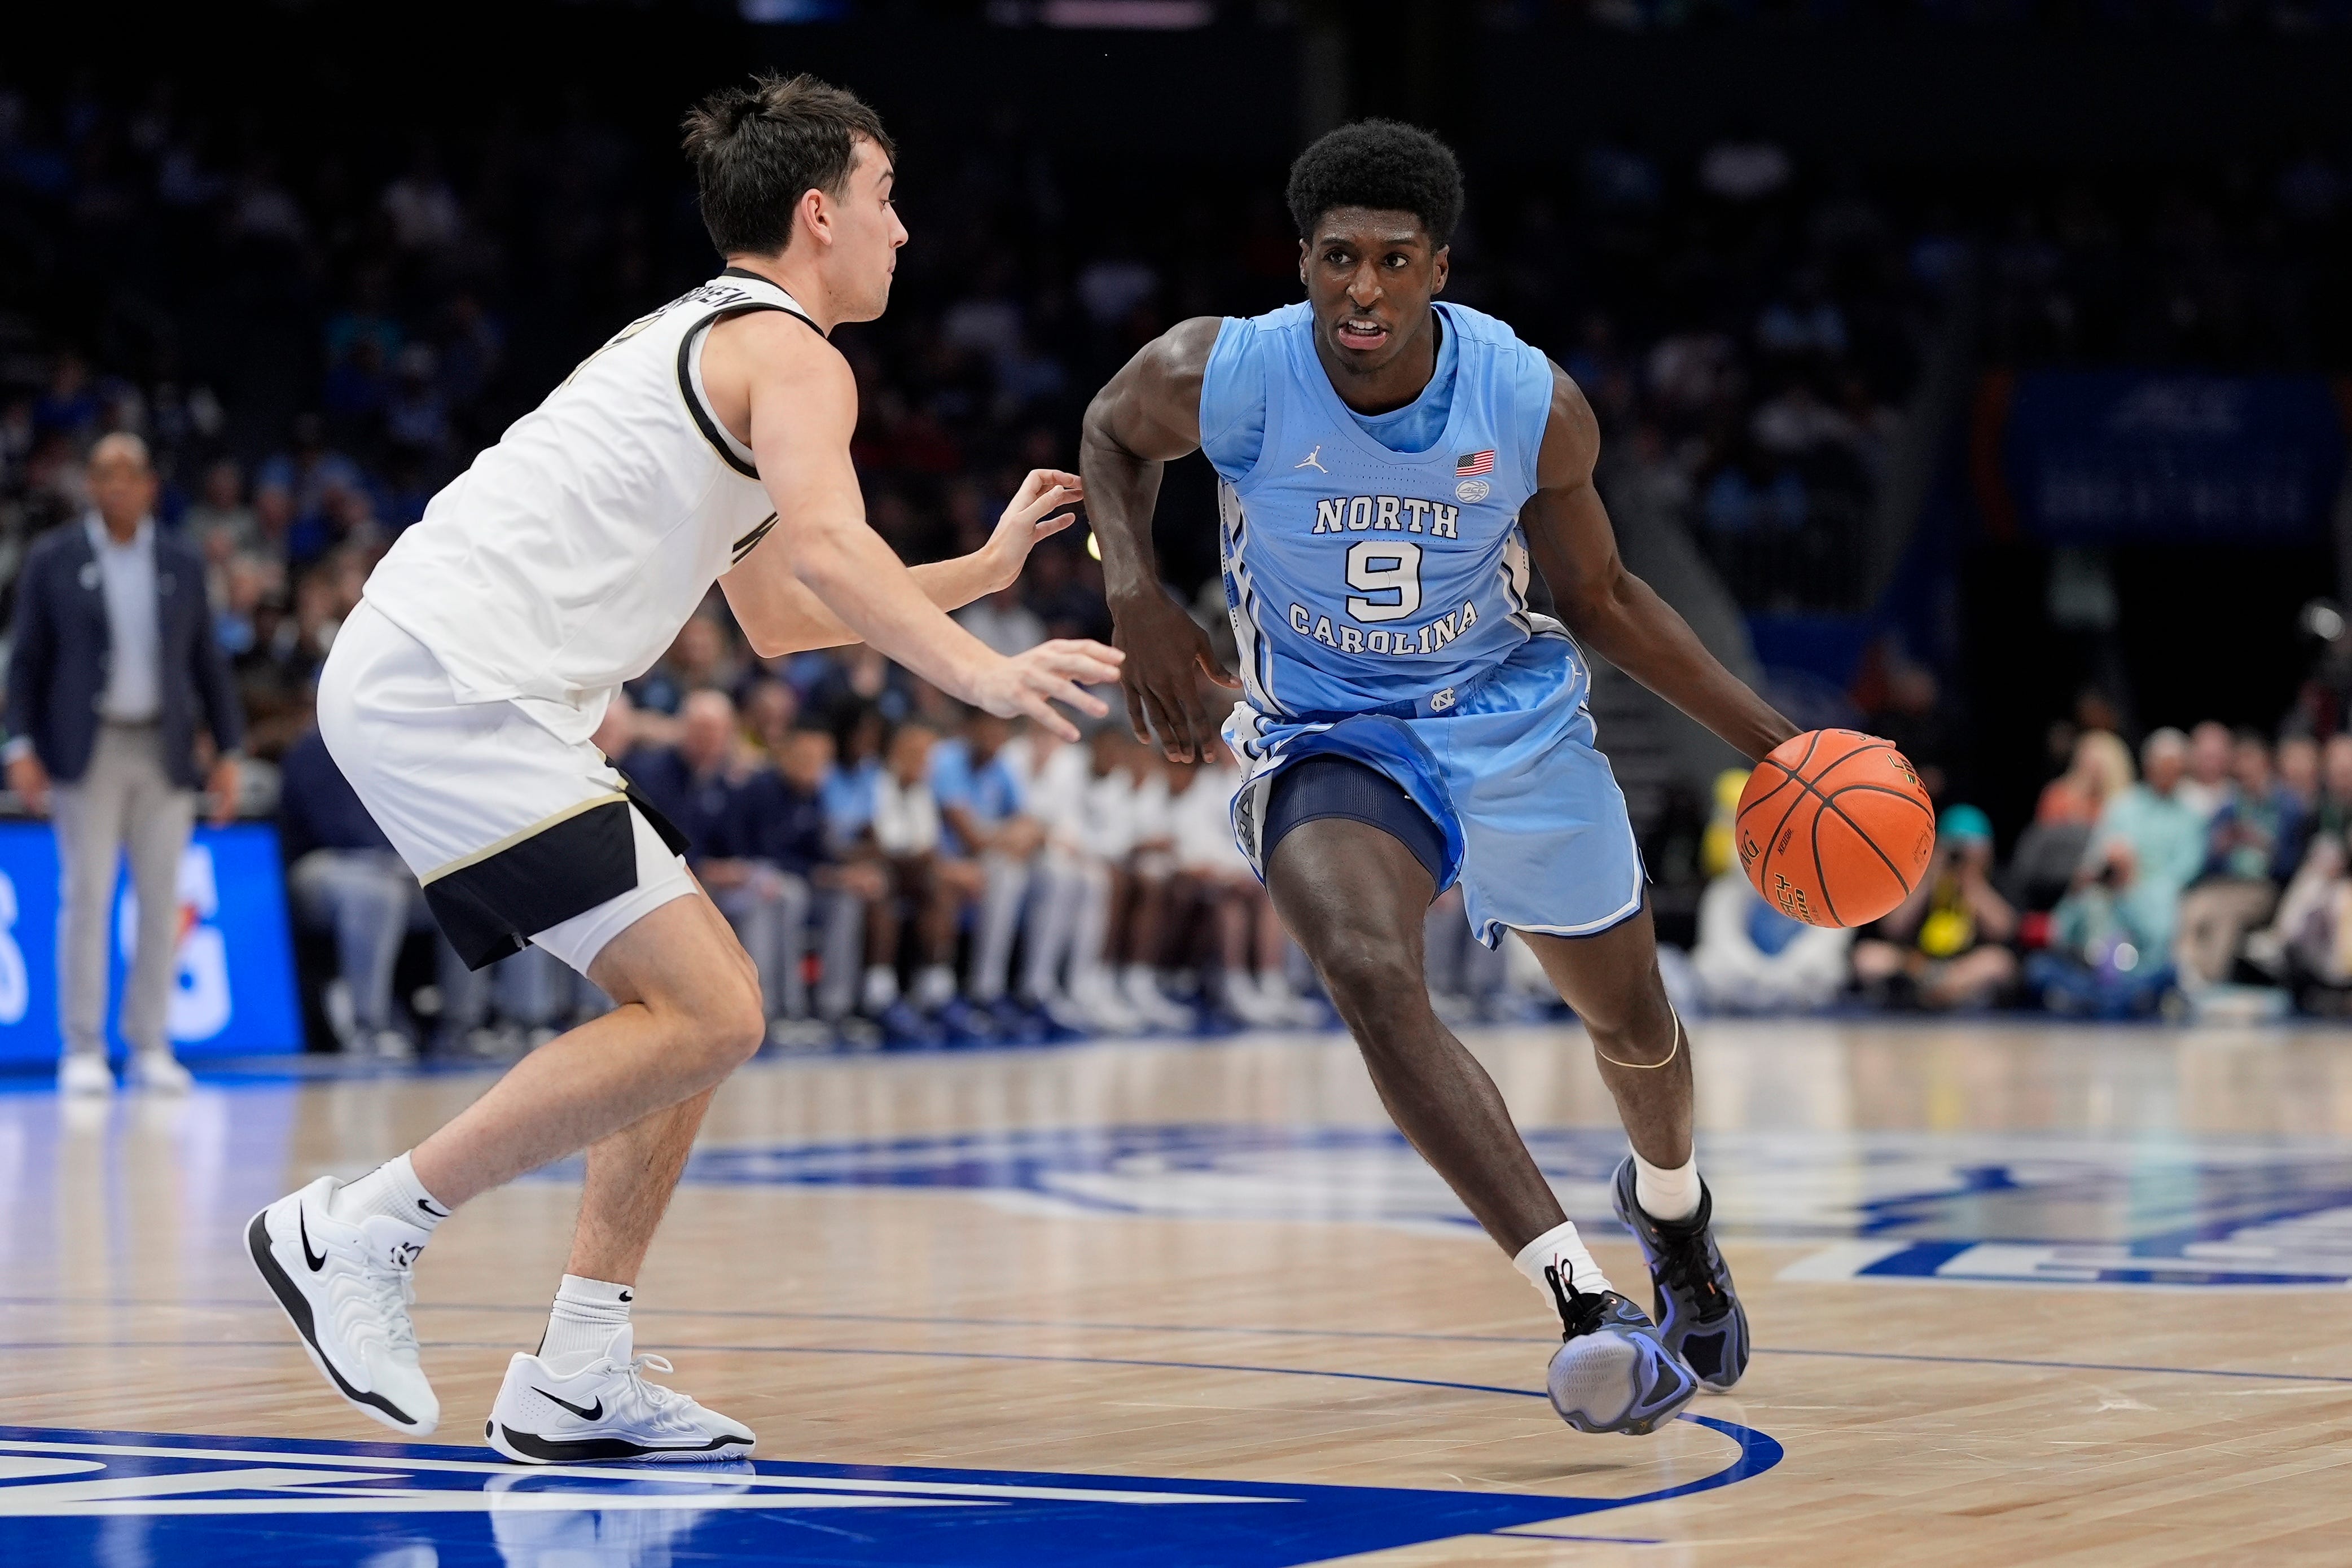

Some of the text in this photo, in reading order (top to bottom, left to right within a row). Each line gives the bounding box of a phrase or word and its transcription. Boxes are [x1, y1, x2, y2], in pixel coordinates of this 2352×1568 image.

[1312, 495, 1459, 540] NORTH
[1345, 540, 1423, 623] 9
[1289, 600, 1478, 655] CAROLINA
